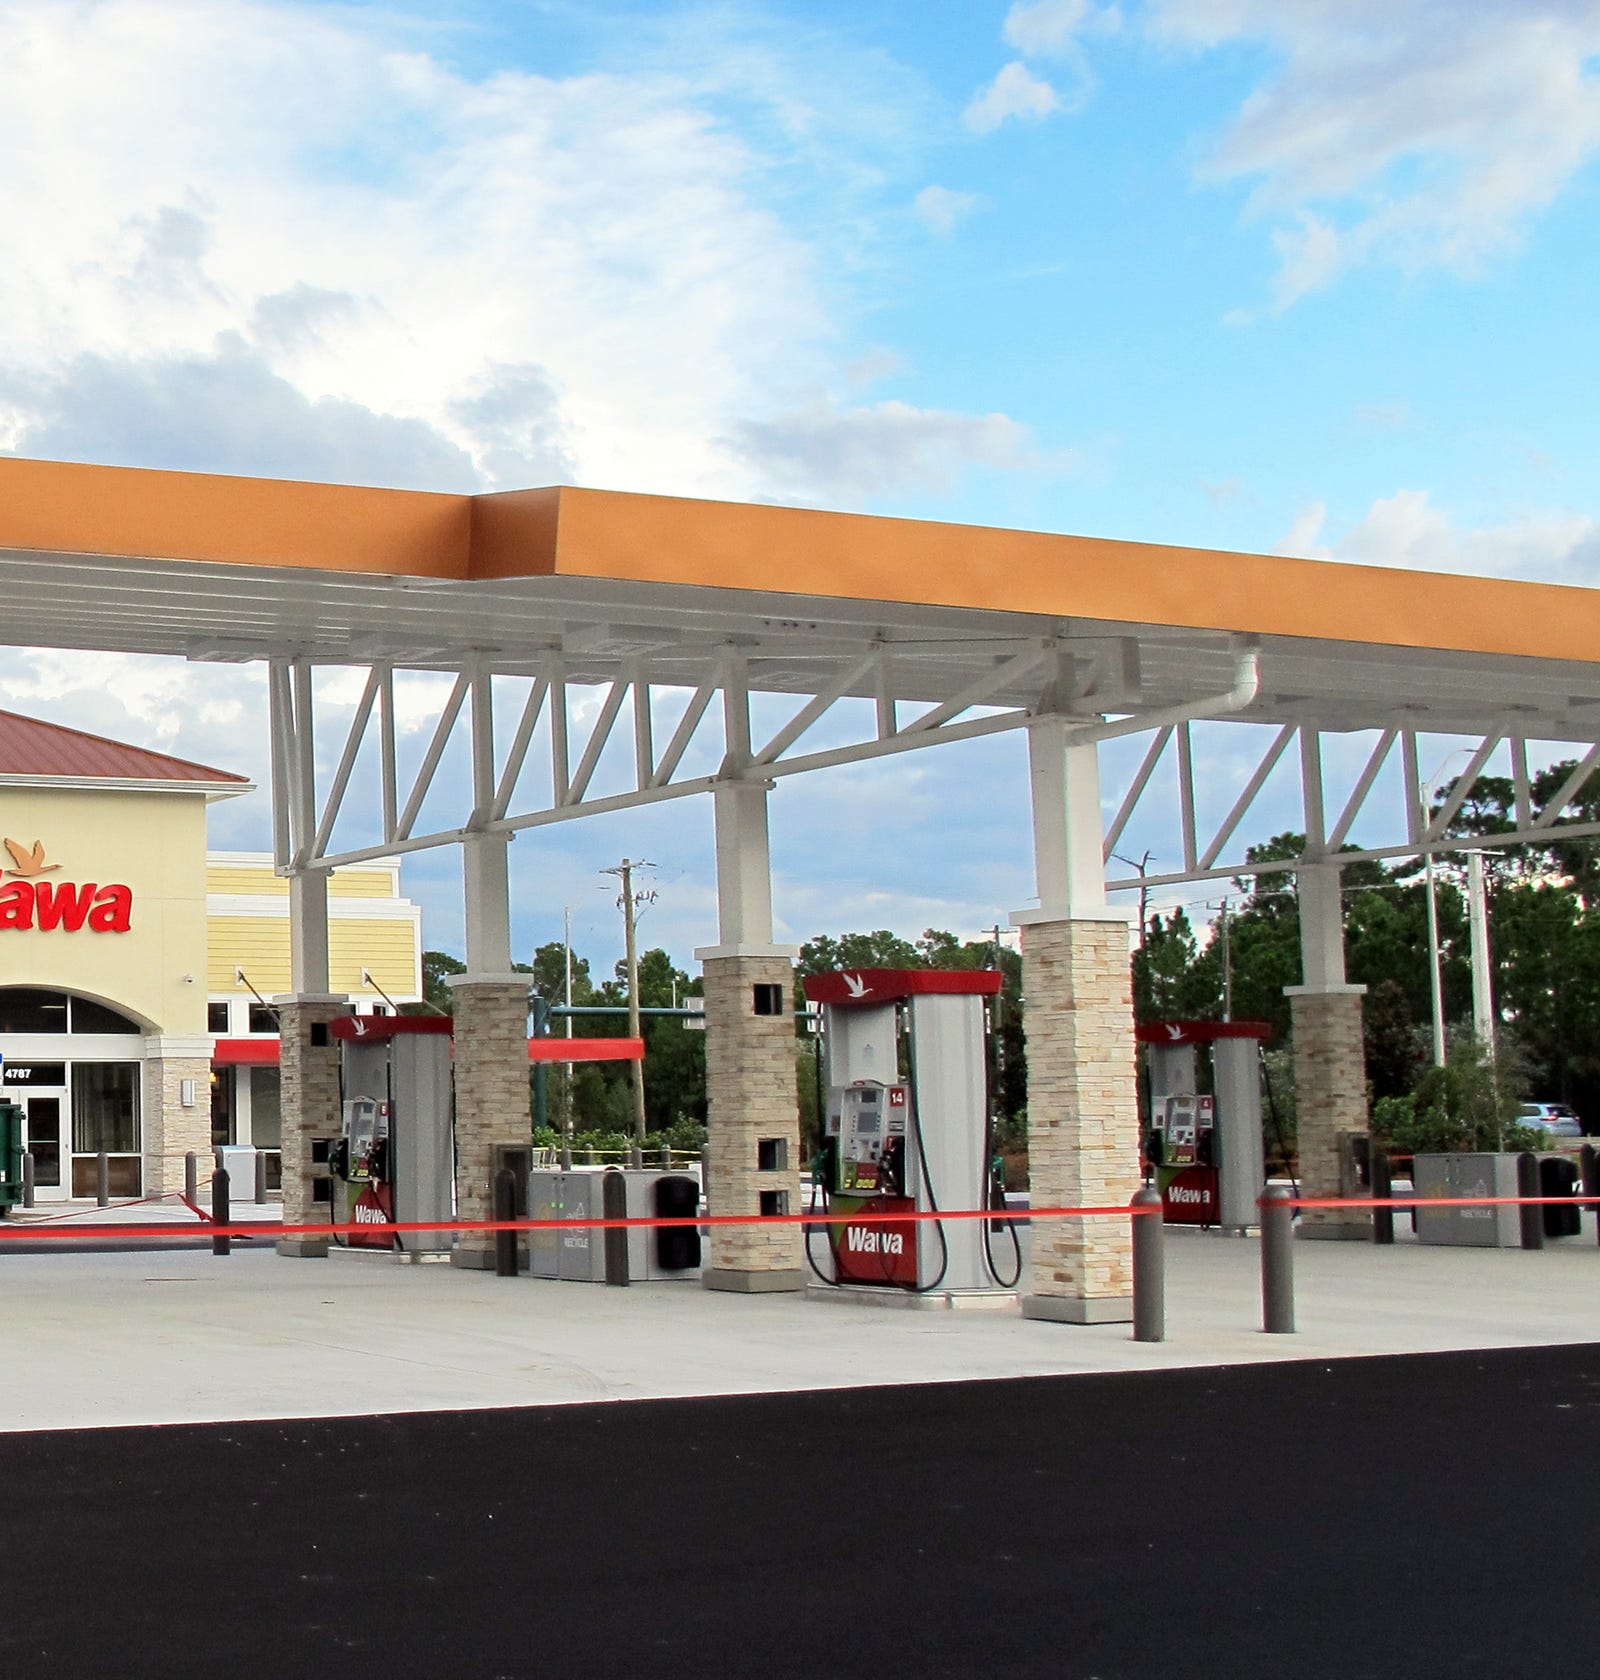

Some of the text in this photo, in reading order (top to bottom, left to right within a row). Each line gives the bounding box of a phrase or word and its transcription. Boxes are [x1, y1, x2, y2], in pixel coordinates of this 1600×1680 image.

[5, 1068, 32, 1079] 4787
[891, 1092, 903, 1104] 14
[1167, 1186, 1211, 1204] Wawa
[355, 1204, 387, 1224] Wawa
[847, 1226, 903, 1255] Wawa
